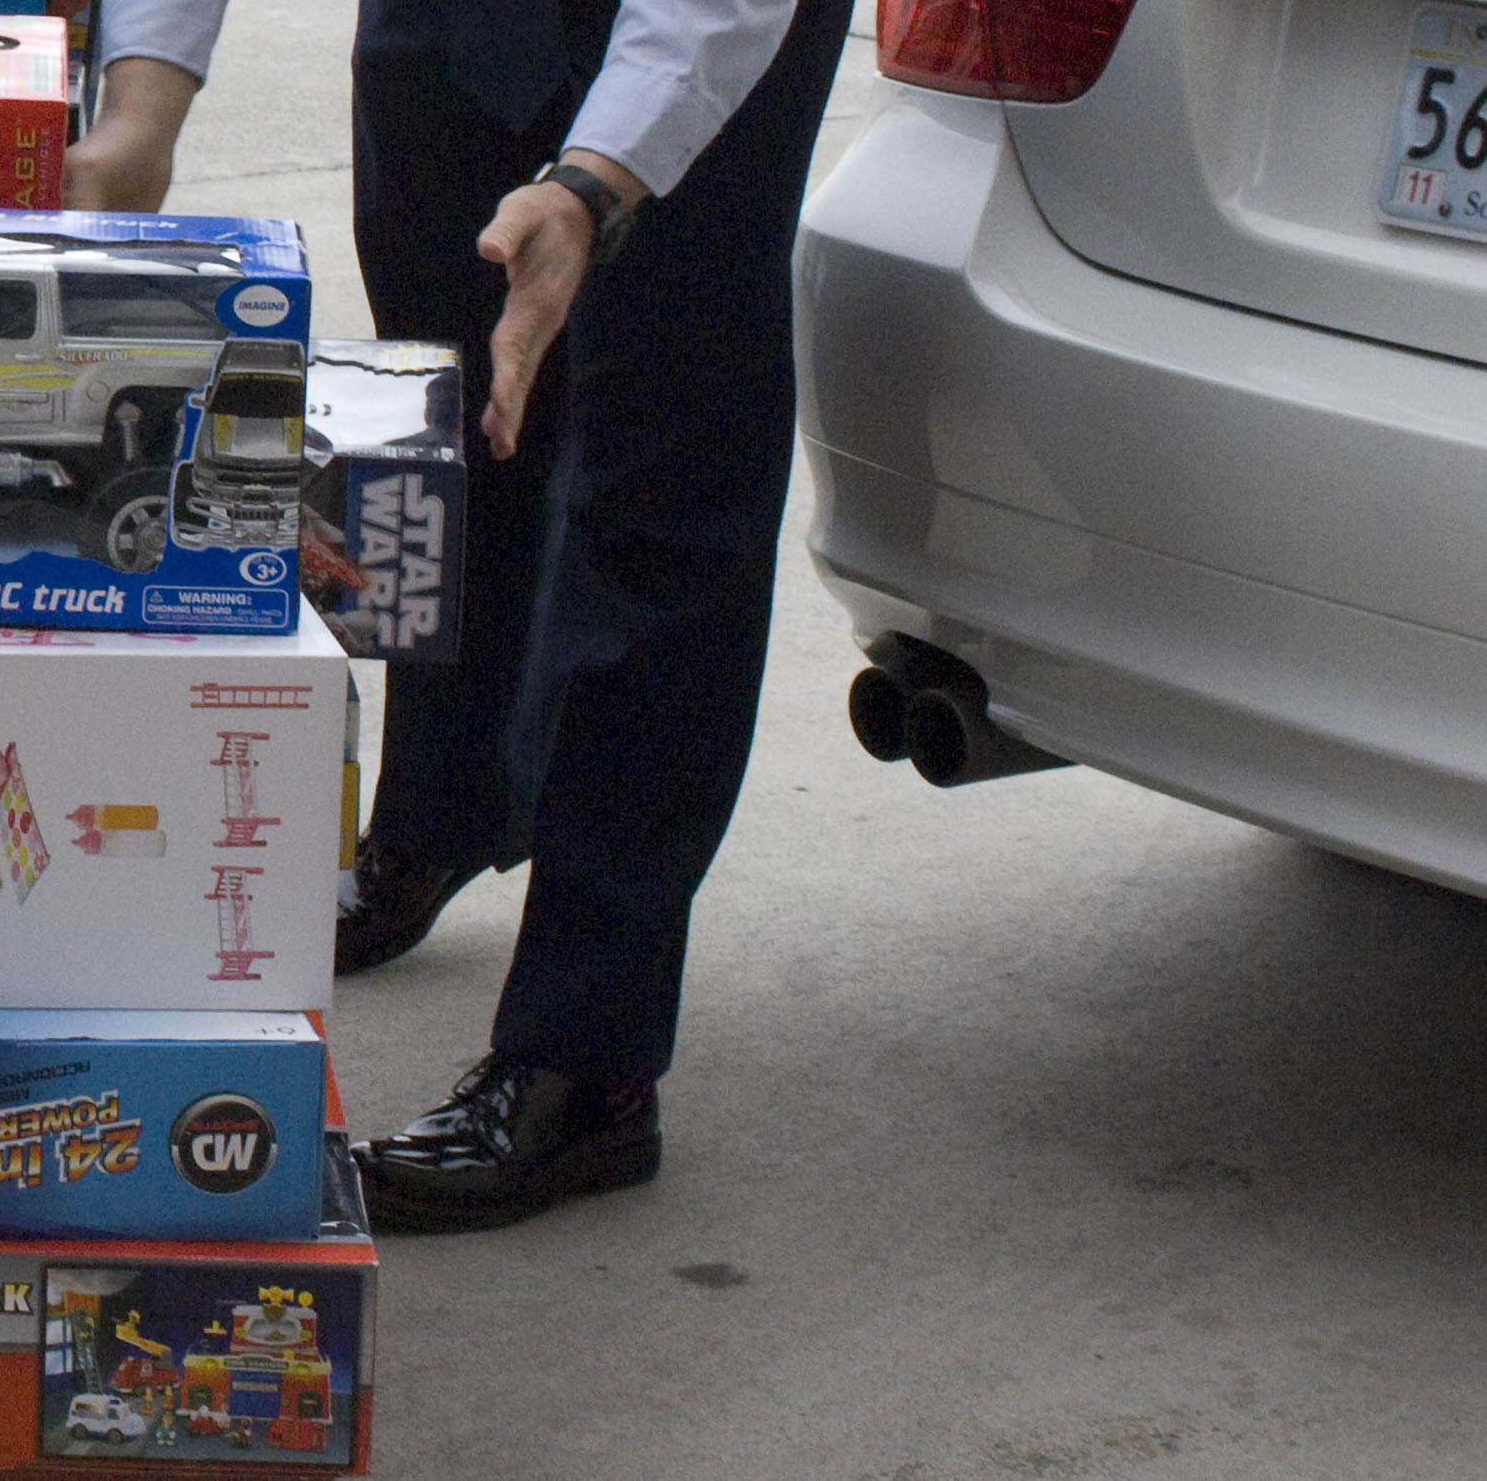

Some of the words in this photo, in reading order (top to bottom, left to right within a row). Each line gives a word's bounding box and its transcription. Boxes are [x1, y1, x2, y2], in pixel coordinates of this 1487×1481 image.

[1409, 171, 1434, 205] 11
[238, 300, 287, 312] IMAGINE
[59, 349, 128, 362] SILVERADO
[396, 473, 445, 649] STAR
[256, 564, 279, 580] 3+
[33, 583, 127, 614] truck
[179, 591, 252, 606] WARNING:
[147, 604, 191, 615] CHOKING
[193, 606, 232, 616] HAZARD
[59, 1123, 141, 1183] 24
